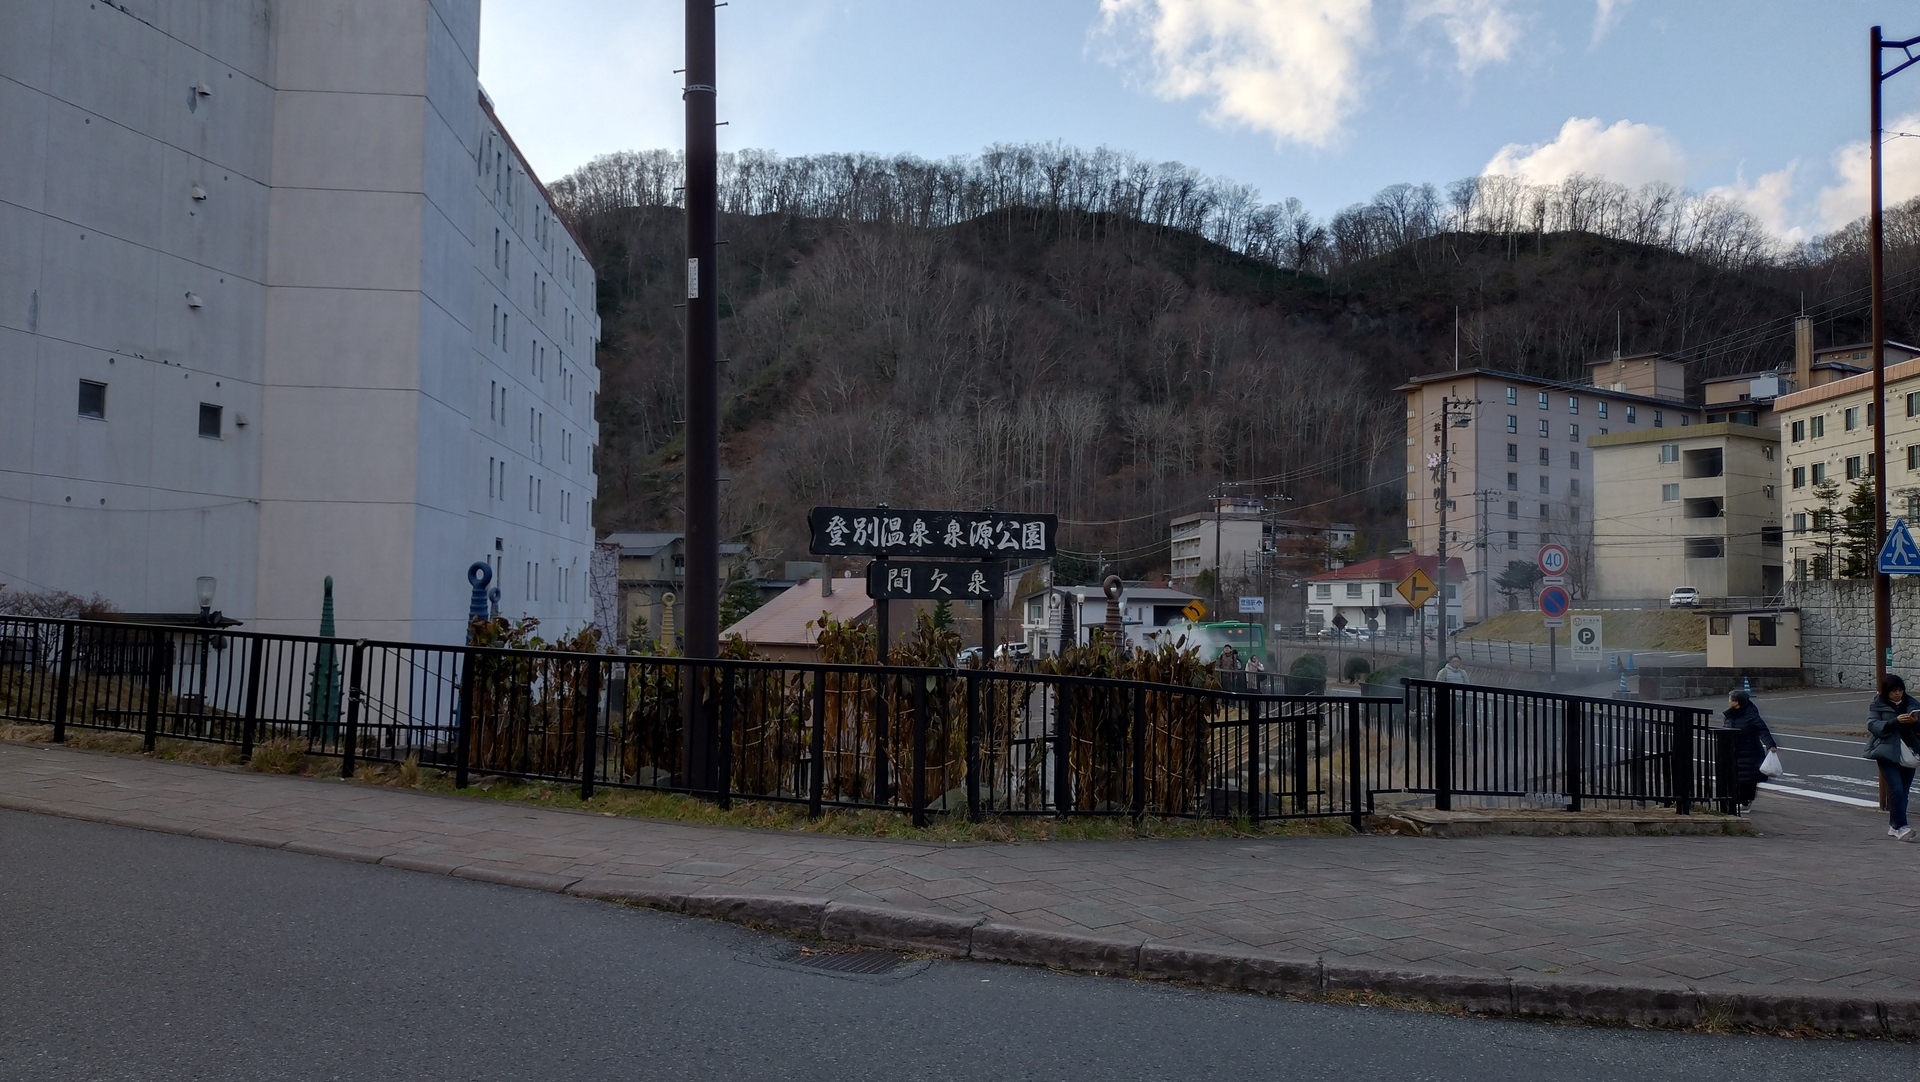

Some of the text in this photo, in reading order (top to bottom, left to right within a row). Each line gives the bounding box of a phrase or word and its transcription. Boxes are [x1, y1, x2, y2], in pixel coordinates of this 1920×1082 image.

[1545, 553, 1562, 567] 40
[887, 567, 990, 594] 間欠泉
